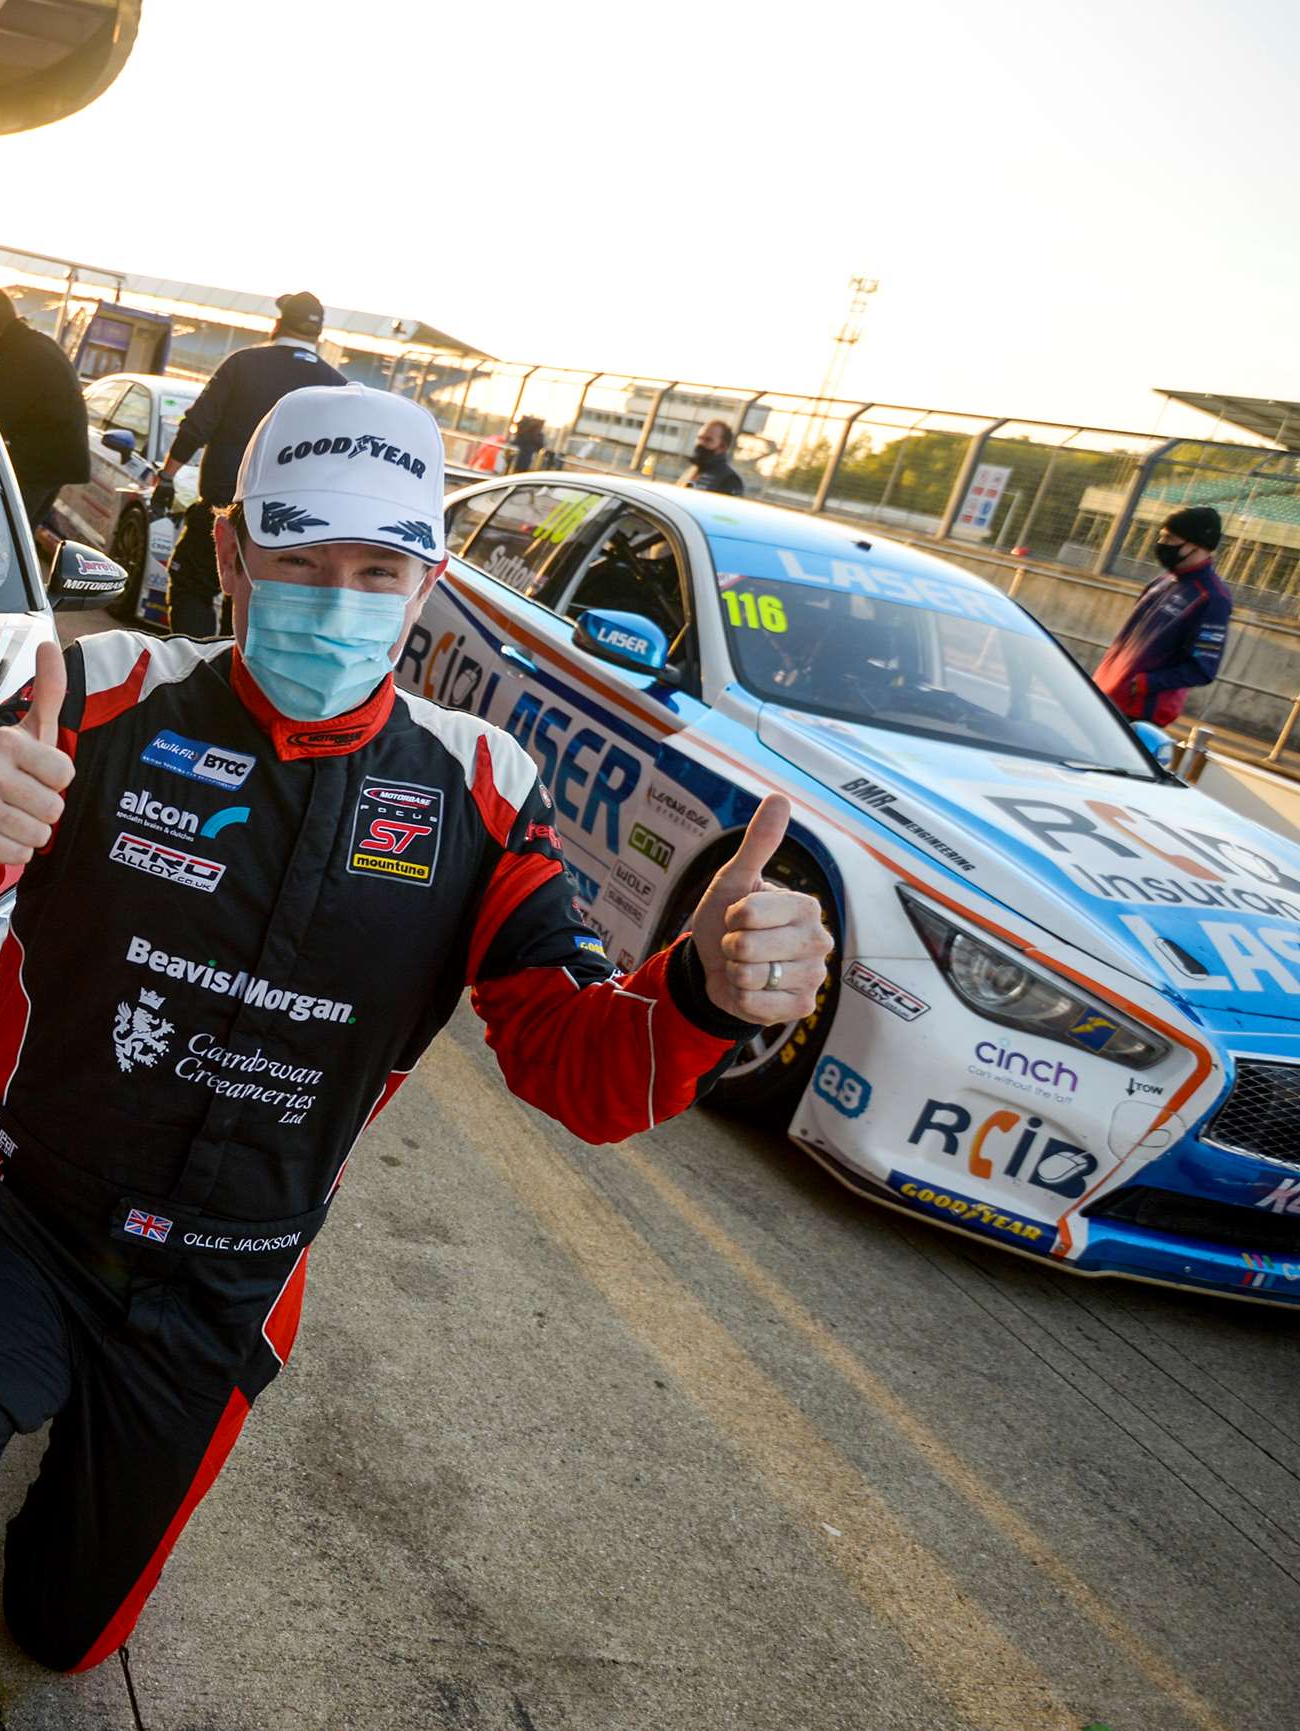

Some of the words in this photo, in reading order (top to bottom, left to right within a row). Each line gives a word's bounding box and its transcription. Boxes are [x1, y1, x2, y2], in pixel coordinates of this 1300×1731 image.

[277, 435, 426, 479] GOODYEAR
[63, 578, 126, 591] MOTORBAS
[777, 550, 1006, 625] LASER
[721, 589, 789, 634] 116
[596, 625, 650, 657] LASER
[203, 753, 249, 777] BTCC
[119, 789, 200, 834] alcon
[360, 804, 438, 823] FOCUS
[379, 791, 432, 806] MOTORBASE
[359, 818, 432, 854] ST
[839, 777, 898, 809] BMR
[905, 823, 976, 872] ENGINEERING
[116, 835, 221, 881] PRO
[356, 856, 426, 876] mountune
[615, 867, 652, 897] WOLF
[974, 1036, 1079, 1093] cinch
[1135, 1081, 1164, 1096] TOW
[278, 1111, 308, 1125] Ltd
[900, 1183, 1043, 1242] GOODYEAR
[183, 1232, 233, 1250] OLLIE
[234, 1231, 302, 1252] JACKSON
